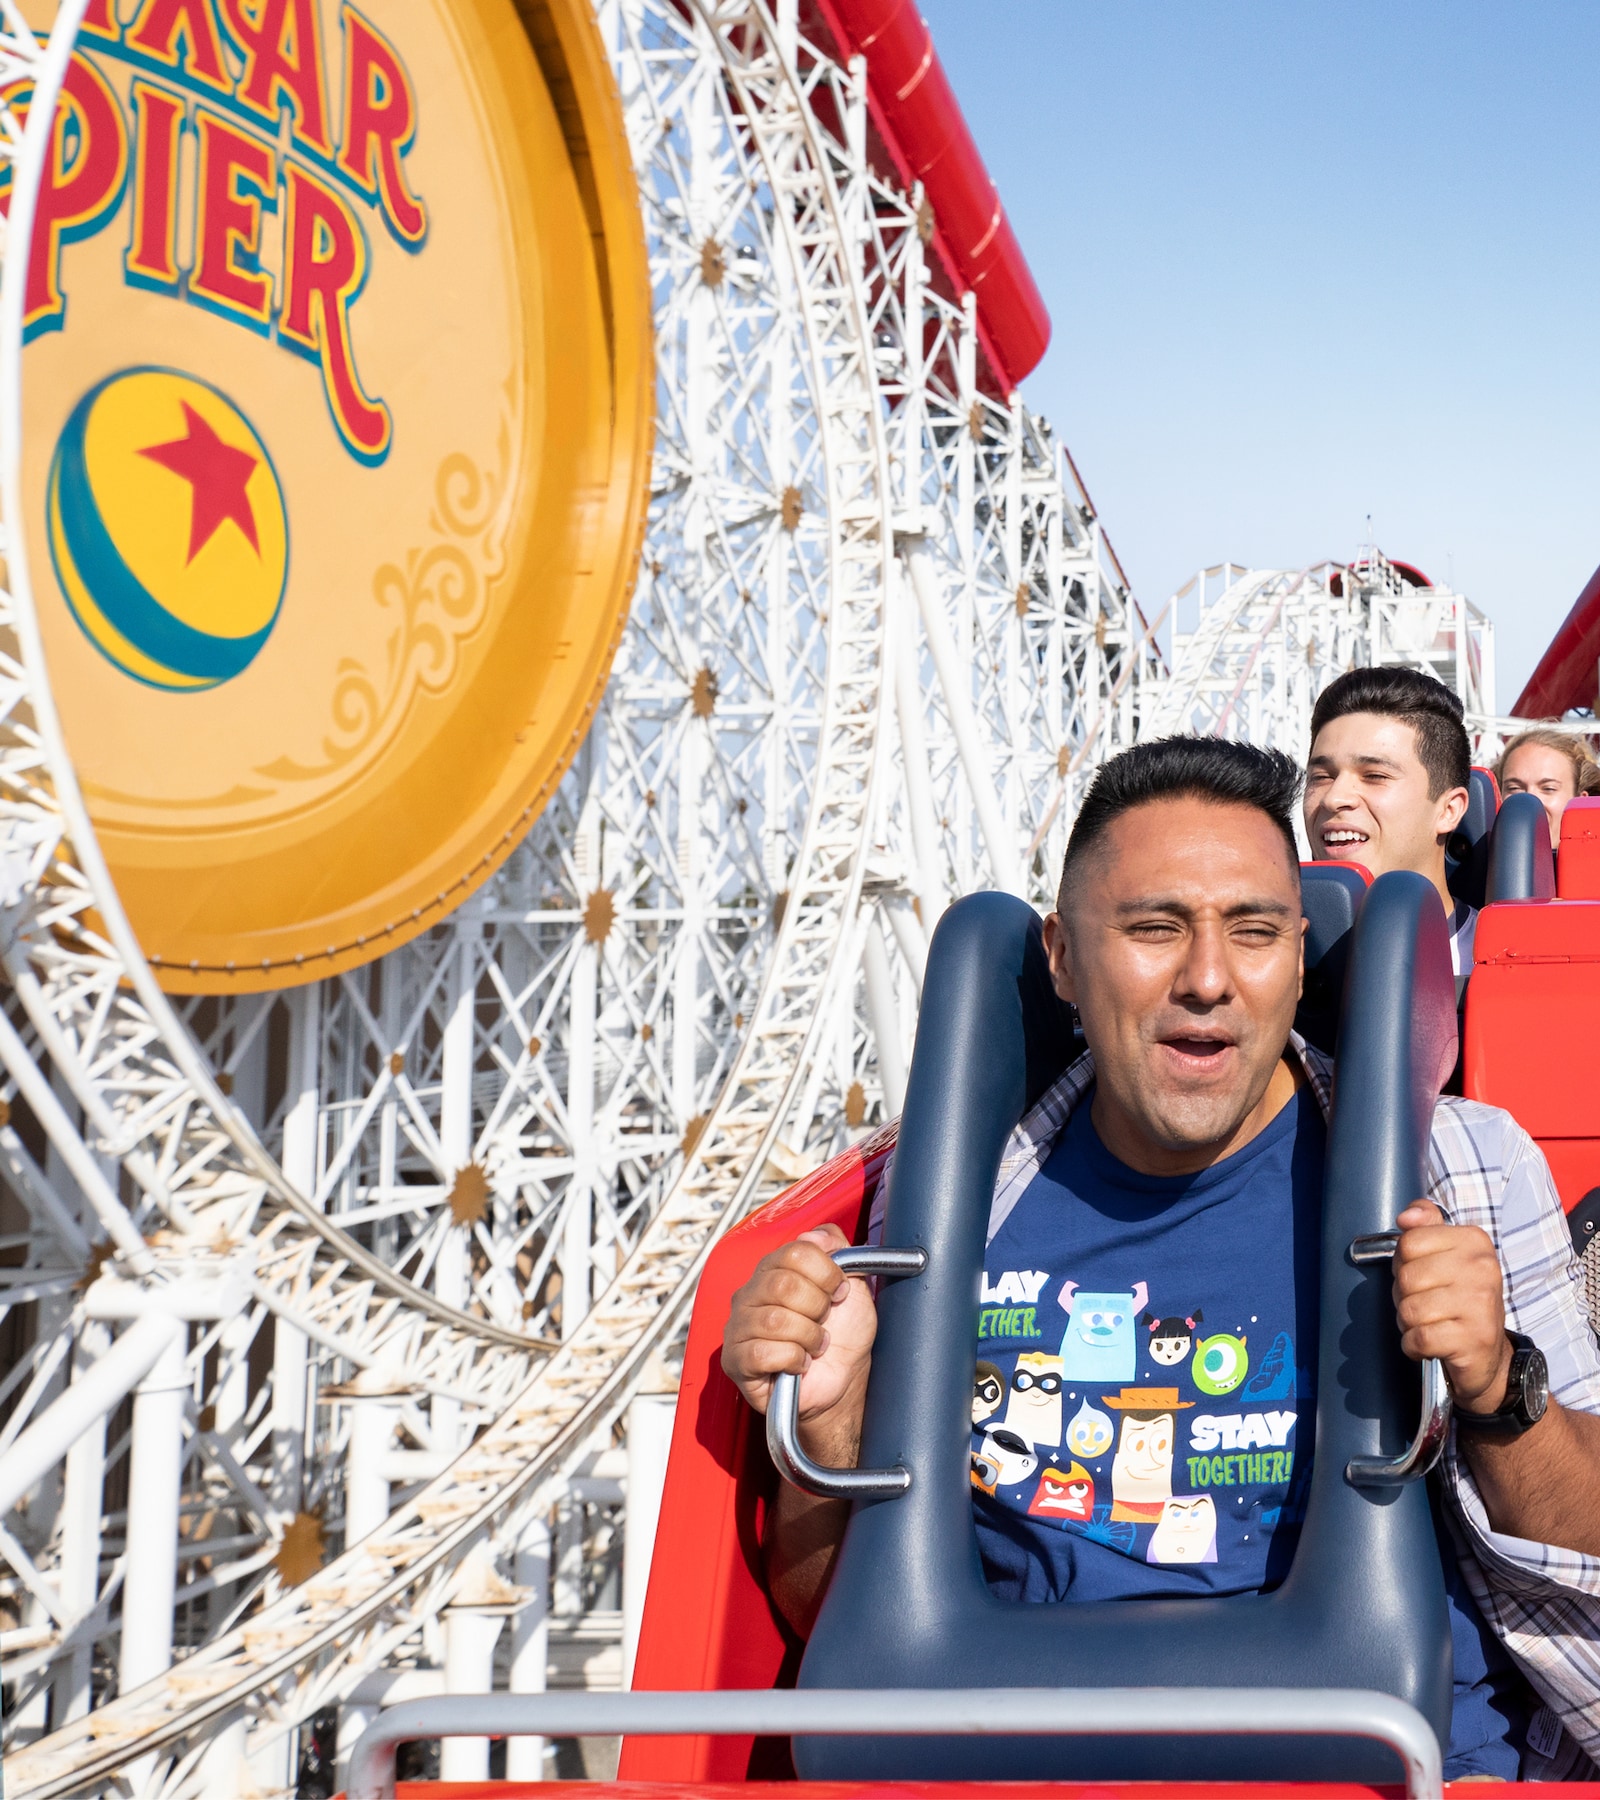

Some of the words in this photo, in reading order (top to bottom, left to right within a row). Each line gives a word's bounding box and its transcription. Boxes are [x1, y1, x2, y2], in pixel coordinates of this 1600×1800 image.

[0, 34, 393, 468] PIER
[1189, 1410, 1298, 1452] STAY
[1186, 1450, 1293, 1488] TOGETHER!
